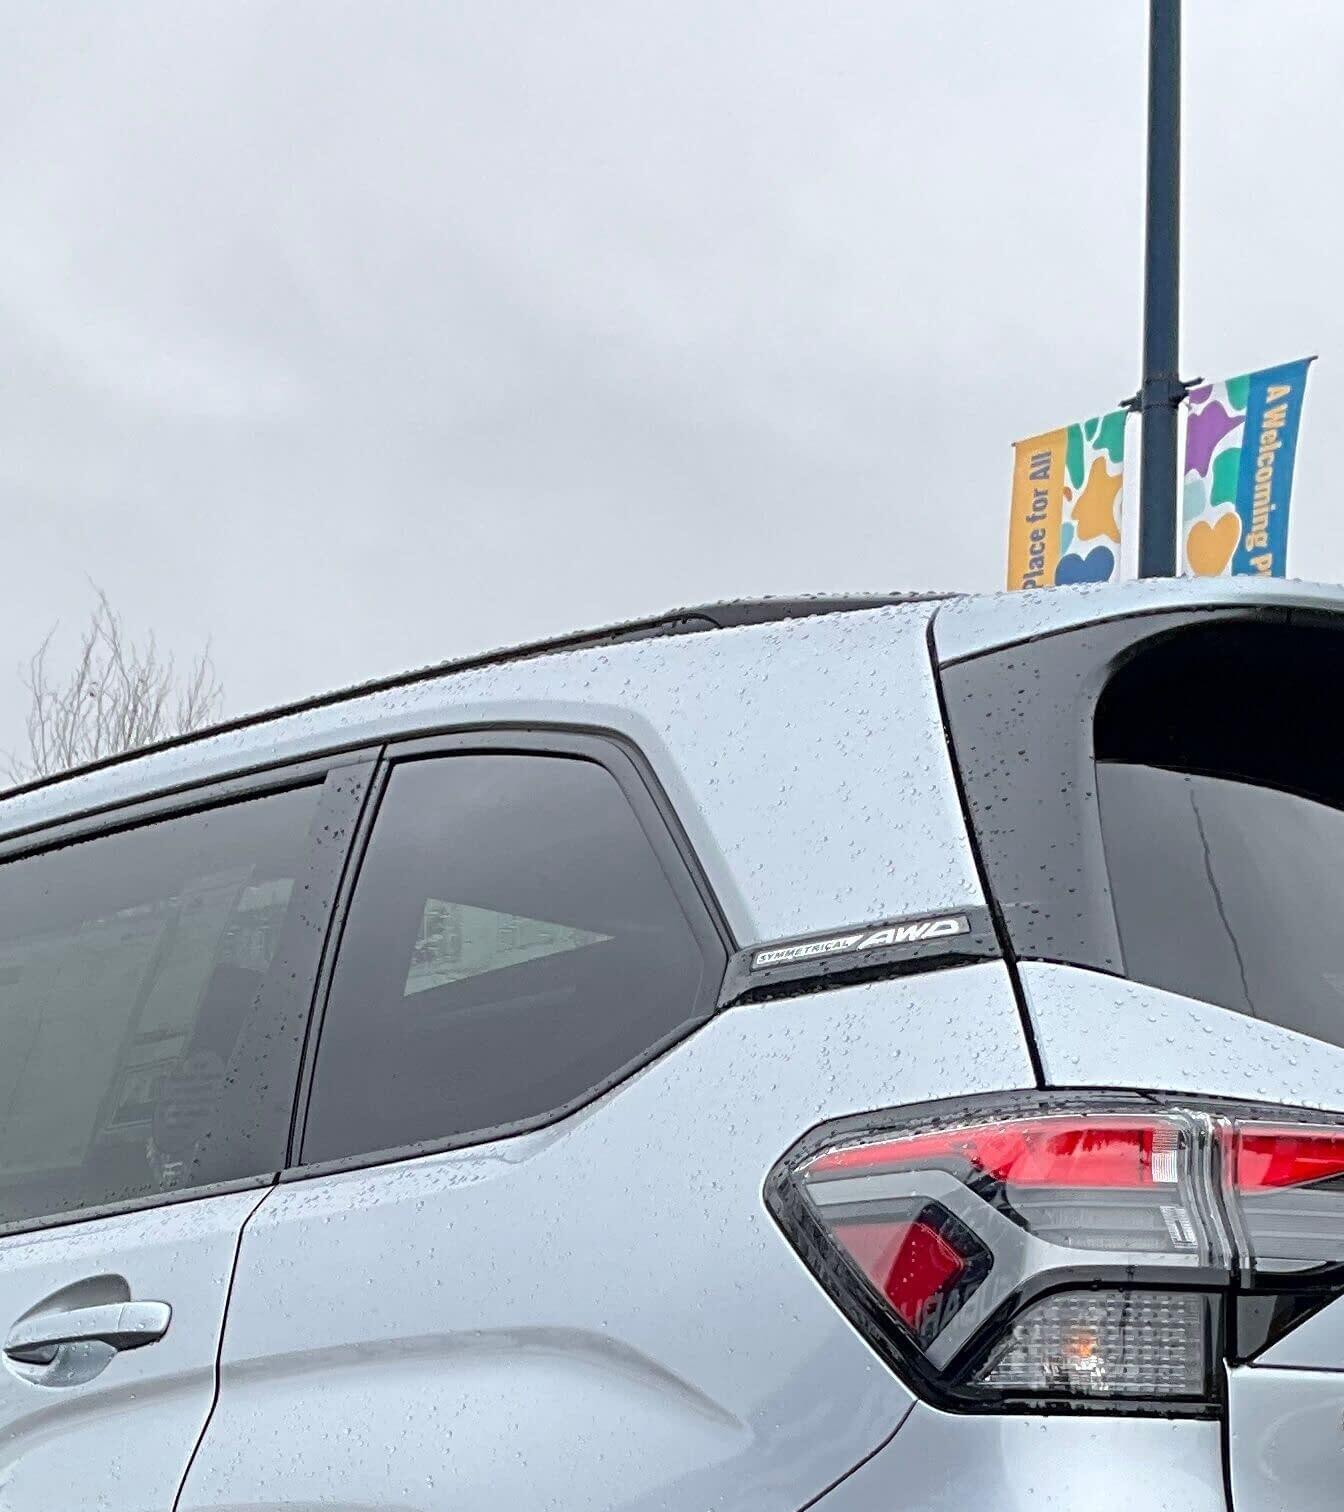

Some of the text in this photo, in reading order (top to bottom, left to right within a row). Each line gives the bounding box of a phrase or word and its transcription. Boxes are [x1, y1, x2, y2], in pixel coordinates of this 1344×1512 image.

[1266, 384, 1291, 404] A
[1022, 451, 1052, 590] Place for All
[1244, 403, 1289, 553] Welcoming
[757, 918, 960, 964] SYMMETRICAL AWD
